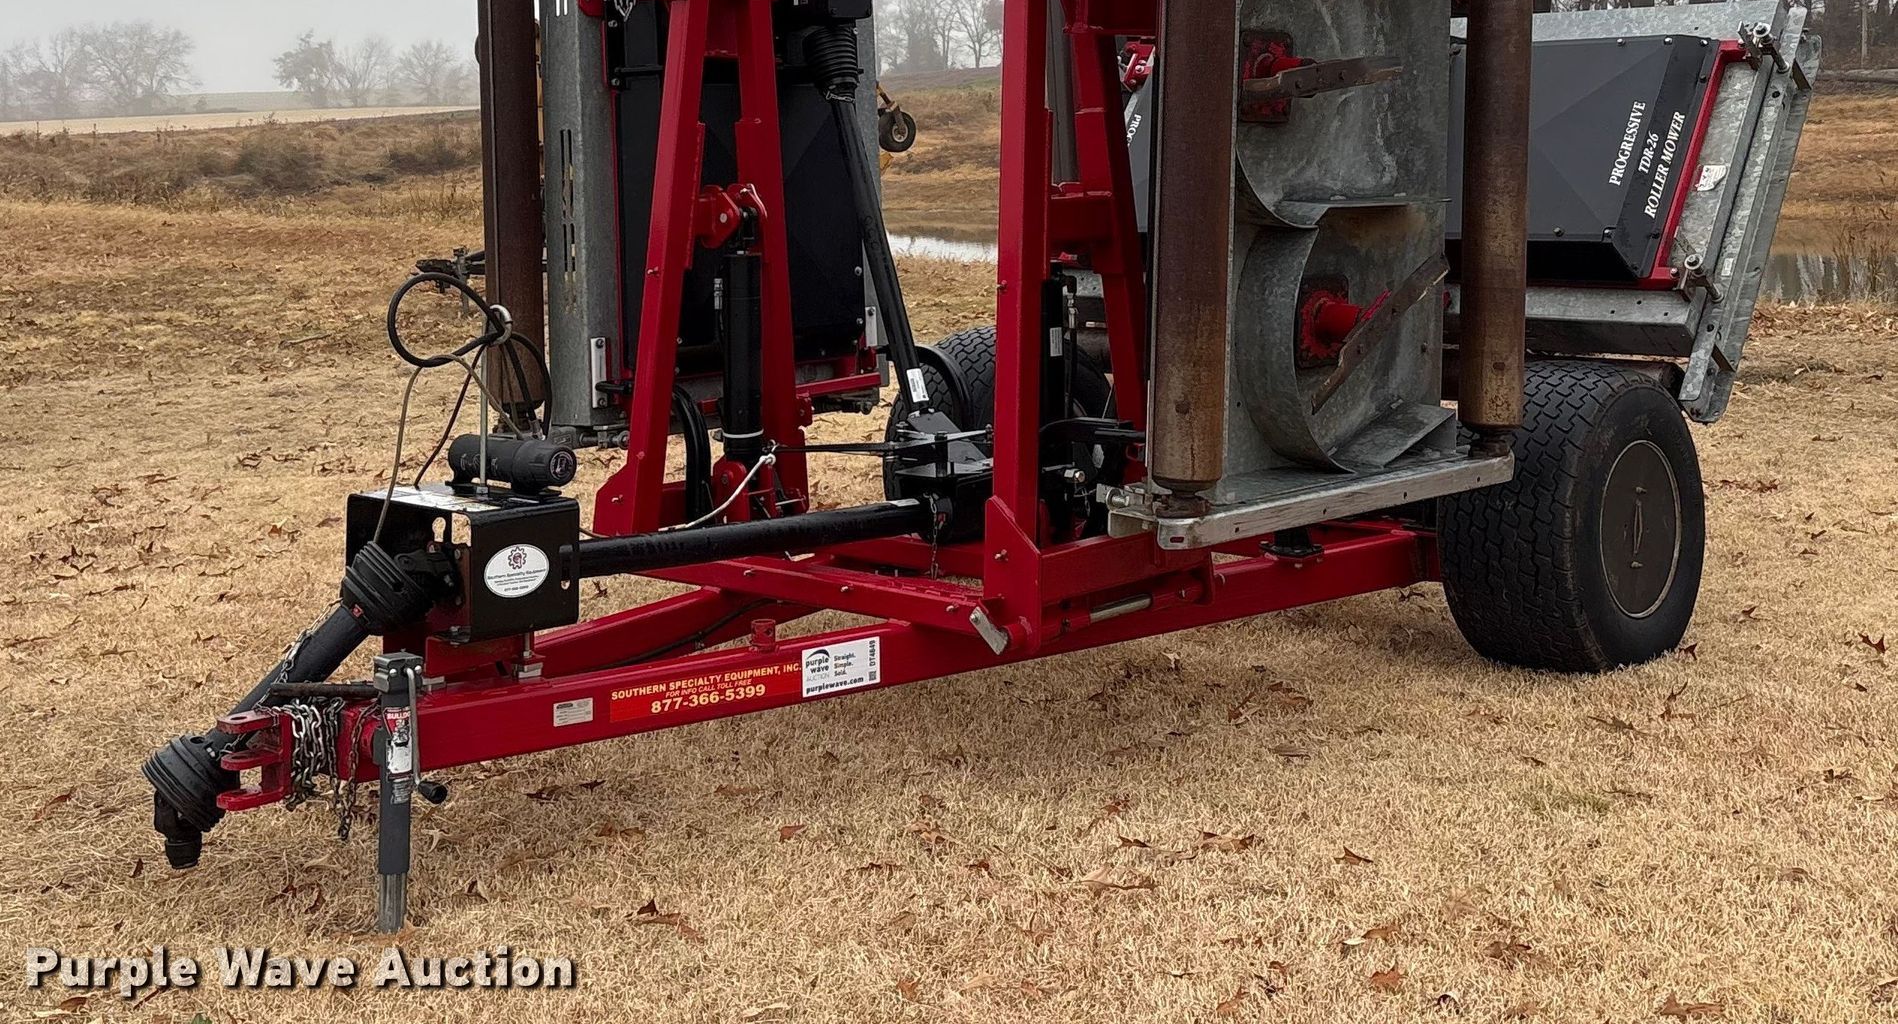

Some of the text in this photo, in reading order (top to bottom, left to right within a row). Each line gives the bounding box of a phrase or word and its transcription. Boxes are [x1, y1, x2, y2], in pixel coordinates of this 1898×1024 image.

[1608, 101, 1646, 186] PROGRESSIVE
[1638, 130, 1659, 174] TDR-26
[1644, 111, 1686, 219] ROLLER MOWER
[805, 656, 830, 668] purple
[810, 665, 829, 674] wave
[833, 661, 853, 669] Simple.
[611, 663, 802, 700] SOUTHERN SPECIALTY EQUIPMENT, INC.
[665, 678, 752, 698] FOR INFO CALL TOLL FREE
[806, 676, 864, 695] purplewave.com
[651, 684, 766, 713] 877-366-5399
